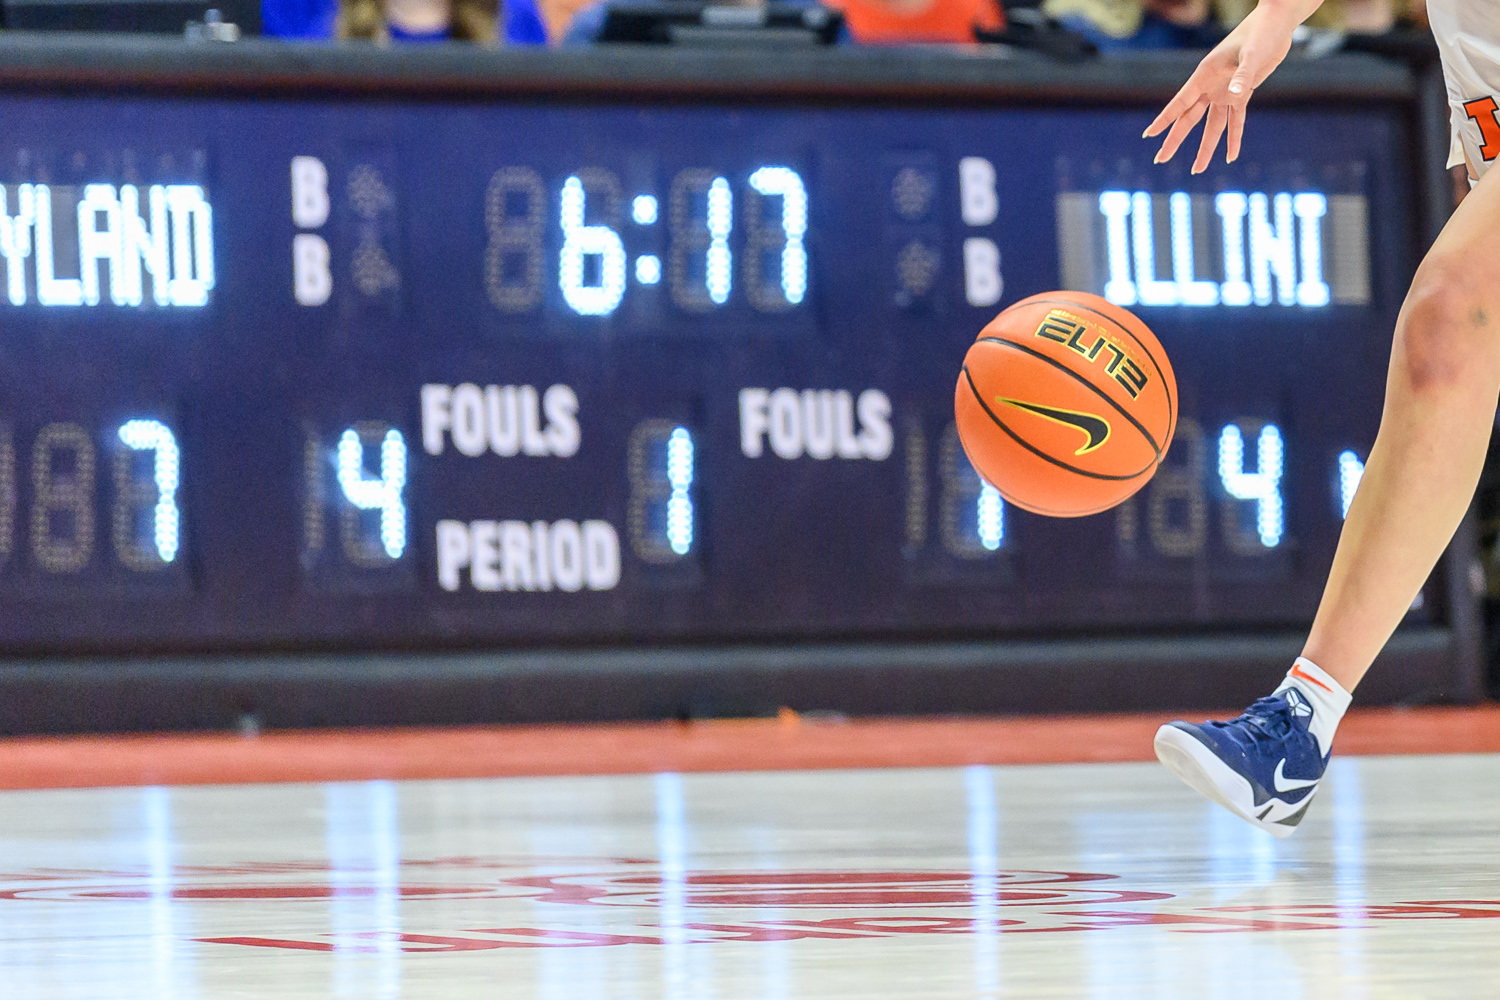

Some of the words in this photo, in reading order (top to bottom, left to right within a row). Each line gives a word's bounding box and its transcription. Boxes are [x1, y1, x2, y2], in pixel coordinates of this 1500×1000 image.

[291, 156, 329, 227] B
[959, 157, 998, 226] B
[293, 234, 332, 305] B
[558, 166, 808, 315] 6:17
[964, 237, 1002, 306] B
[1098, 190, 1330, 307] ILLINI
[1035, 313, 1149, 401] ELITE
[421, 383, 581, 457] FOULS
[739, 388, 893, 461] FOULS
[117, 419, 180, 563] 7
[336, 429, 407, 559] 4
[666, 427, 694, 555] 1
[1218, 424, 1284, 547] 4
[436, 519, 621, 592] PERIOD
